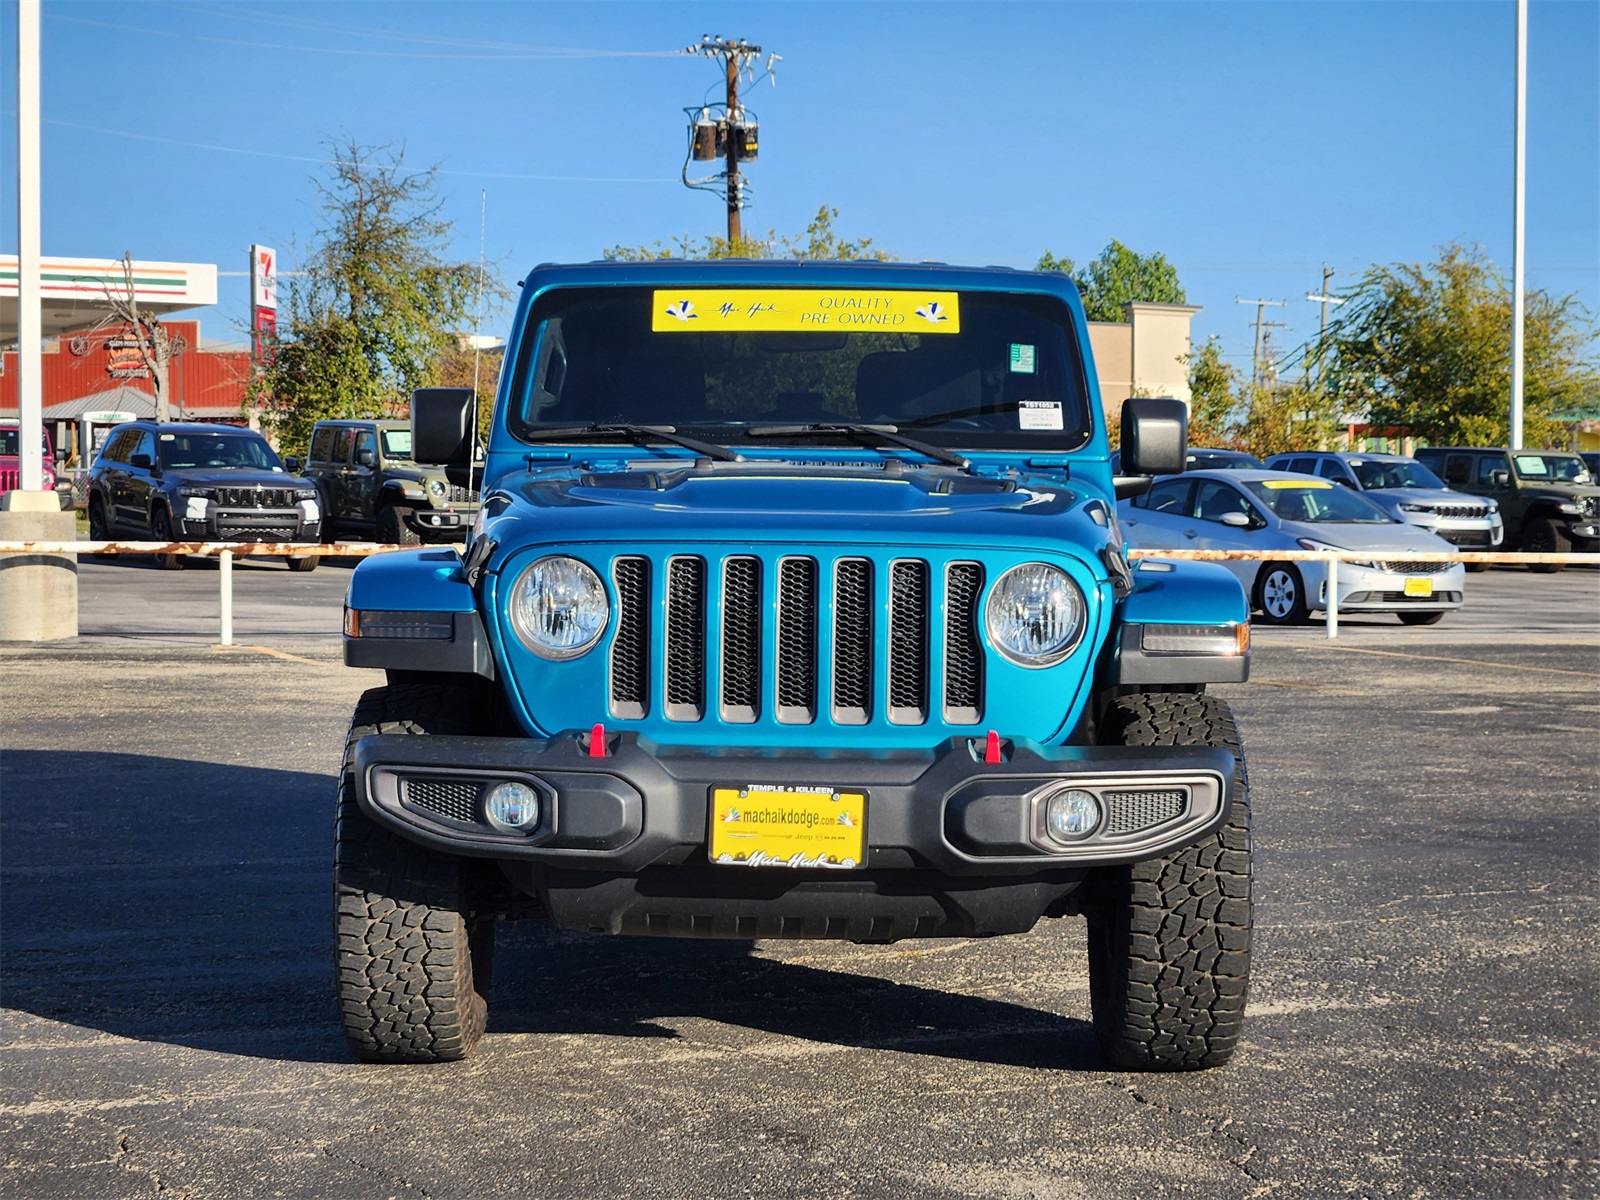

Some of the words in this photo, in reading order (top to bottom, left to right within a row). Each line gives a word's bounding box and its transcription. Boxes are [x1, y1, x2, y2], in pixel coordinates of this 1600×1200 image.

[819, 297, 894, 309] QUALITY
[800, 312, 905, 325] PRE-OWNED
[747, 784, 784, 792] TEMPLE
[795, 787, 834, 795] KILLEEN
[743, 808, 836, 828] machaikdodge.com
[795, 833, 813, 841] Jeep
[747, 850, 784, 868] Mac
[786, 852, 830, 869] Haik
